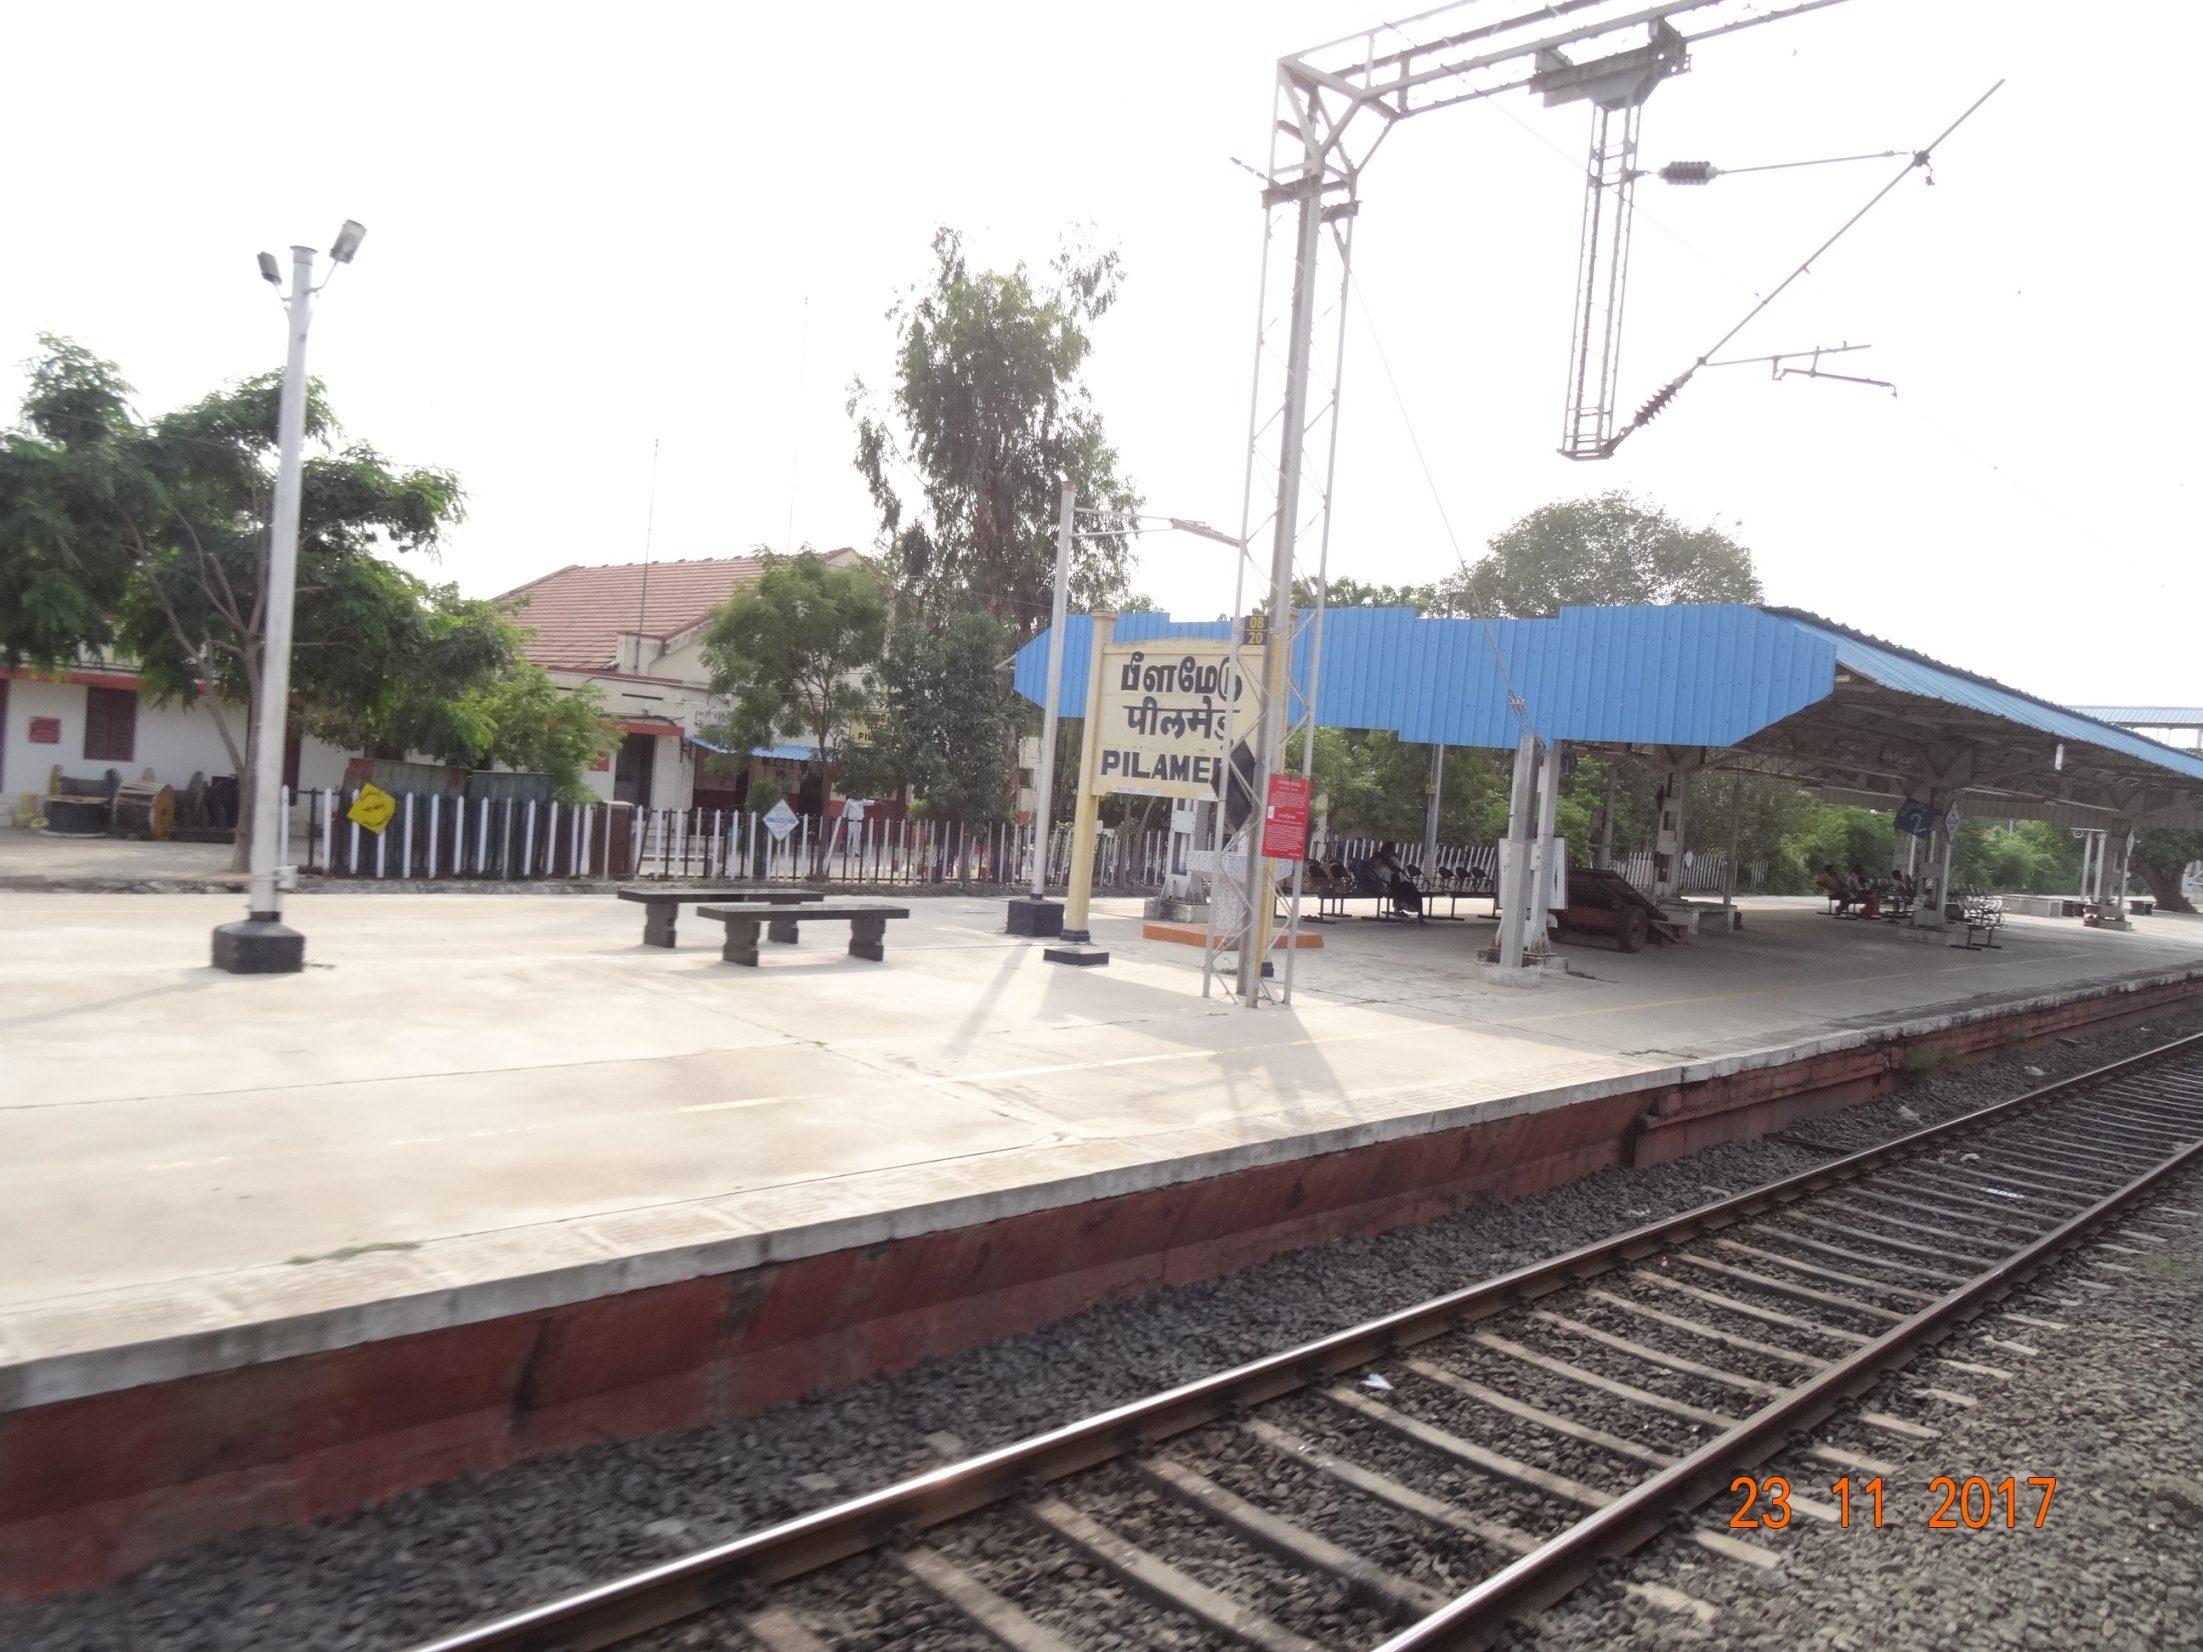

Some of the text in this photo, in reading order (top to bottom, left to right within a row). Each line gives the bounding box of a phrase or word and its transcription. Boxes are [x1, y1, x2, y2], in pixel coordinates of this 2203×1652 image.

[1250, 616, 1265, 629] 08
[1248, 631, 1263, 644] 20
[1101, 749, 1222, 785] PILAME
[1910, 813, 1927, 833] 2
